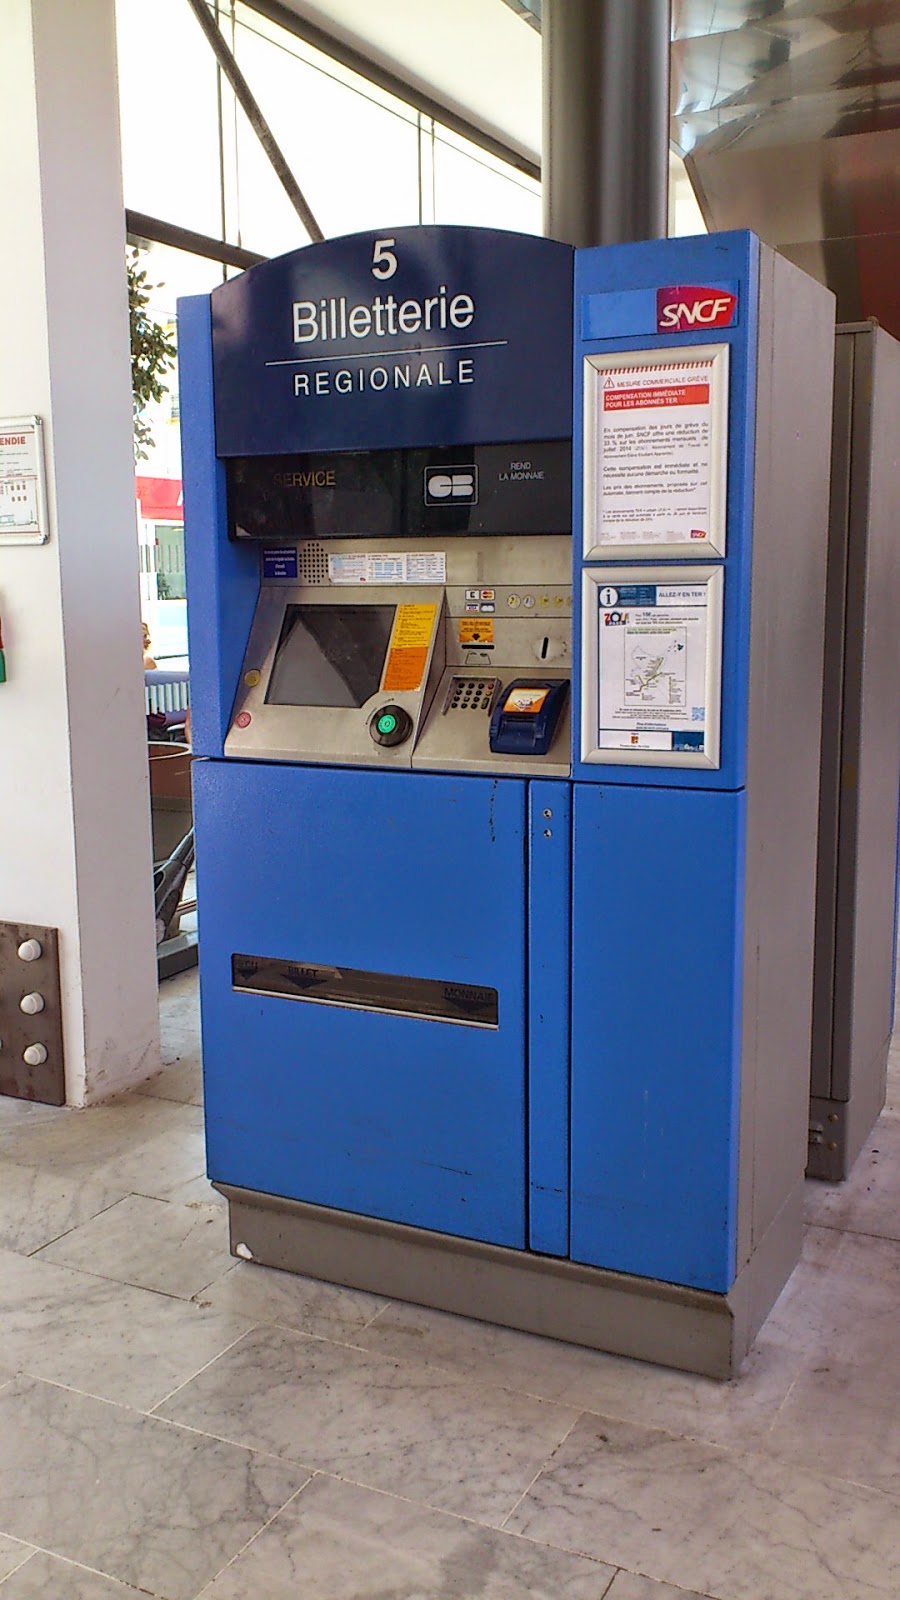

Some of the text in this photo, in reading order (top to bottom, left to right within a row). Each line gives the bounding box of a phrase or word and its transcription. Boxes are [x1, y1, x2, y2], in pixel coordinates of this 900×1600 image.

[371, 238, 398, 281] 5
[292, 285, 475, 344] Billetterie
[659, 297, 731, 327] SNCF
[294, 359, 474, 397] REGIONALE
[642, 377, 685, 386] COMMERCIALE
[606, 389, 686, 401] COMPENSATION IMMÉDIATE
[636, 397, 664, 406] ABONNÉS
[510, 462, 531, 470] REND
[274, 470, 337, 487] SERVICE
[498, 471, 545, 481] LA MONNAIE
